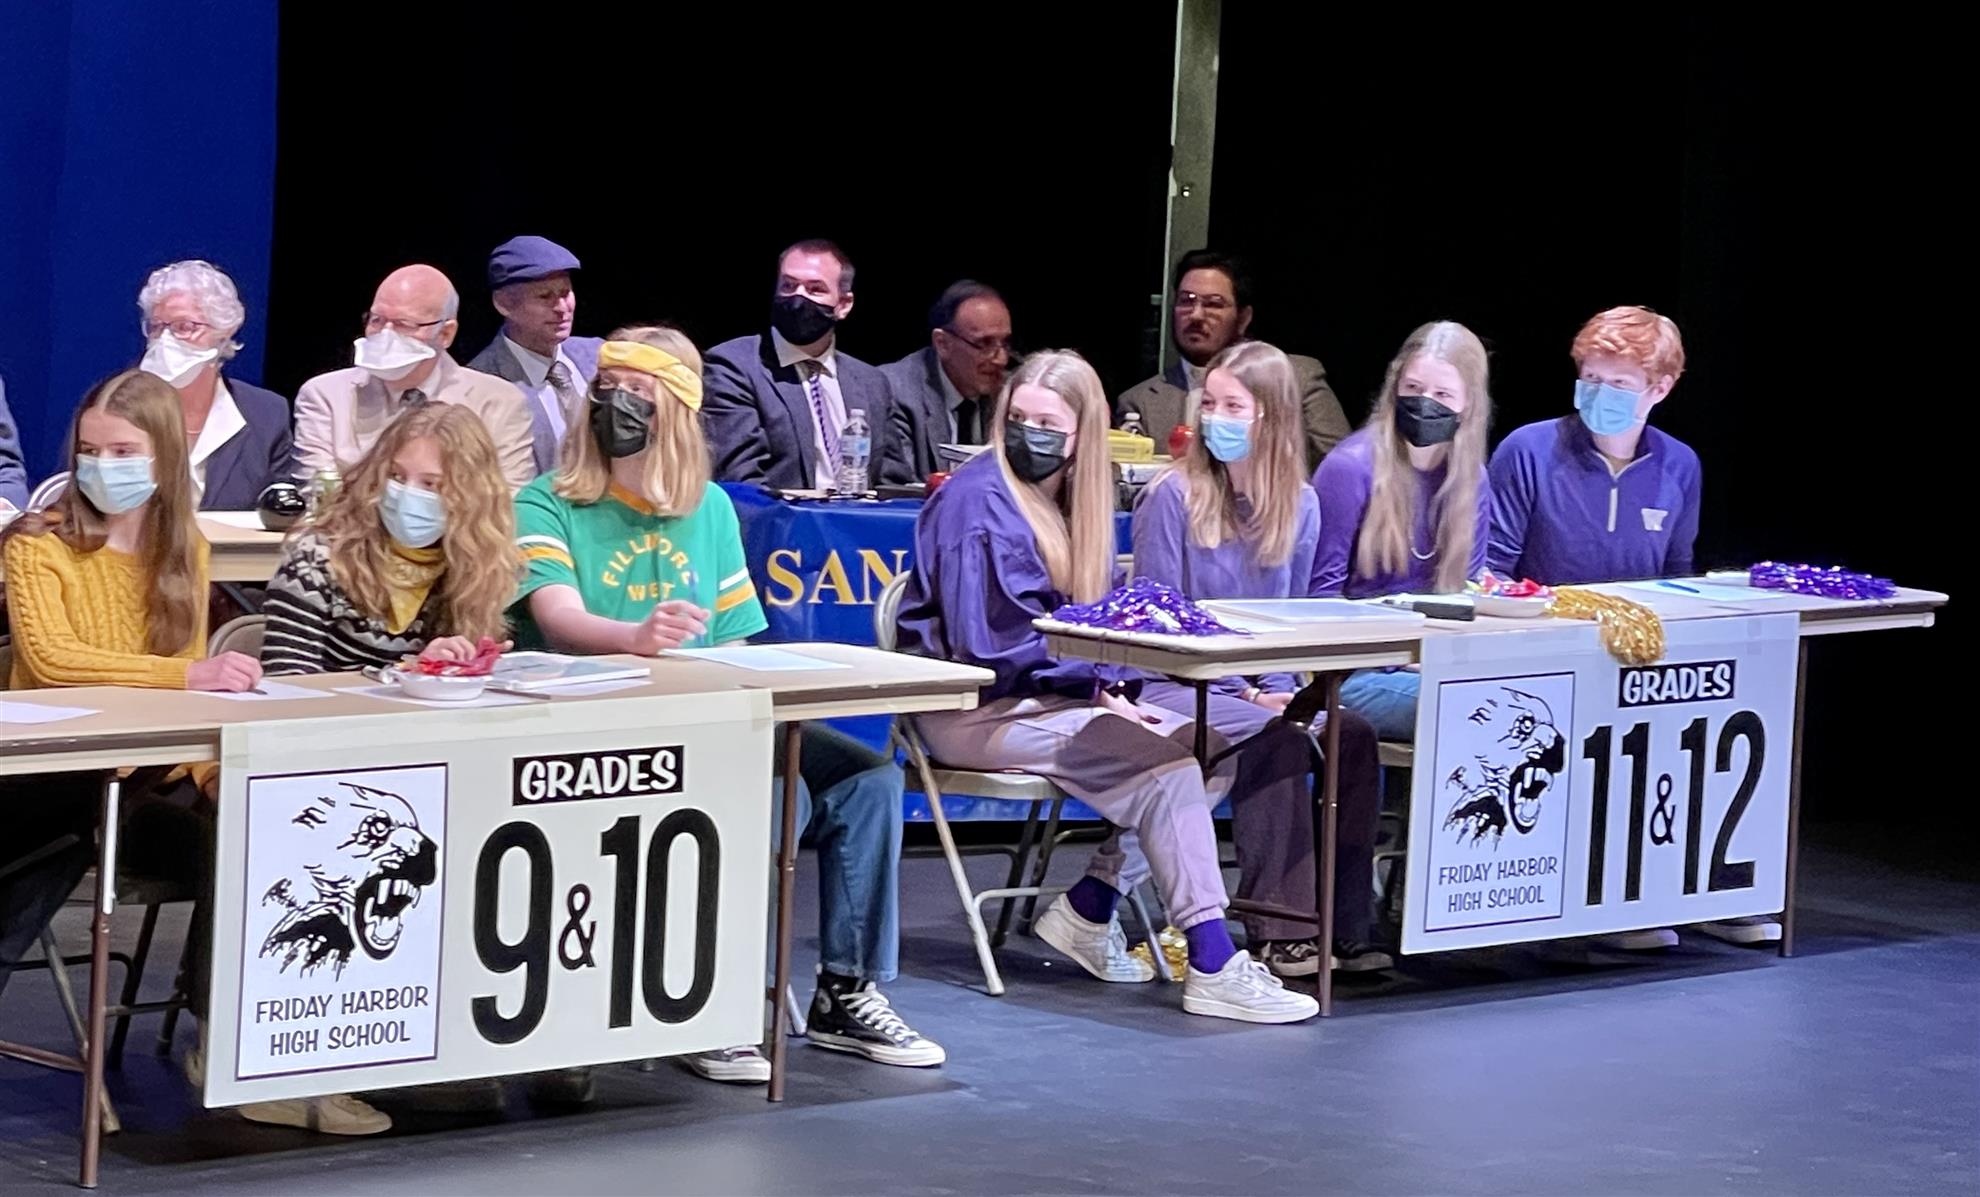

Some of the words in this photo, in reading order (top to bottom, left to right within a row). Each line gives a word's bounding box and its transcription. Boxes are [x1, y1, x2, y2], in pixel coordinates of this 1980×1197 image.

[765, 549, 909, 606] SAN
[1623, 663, 1731, 704] GRADES
[520, 749, 677, 801] GRADES
[1438, 862, 1493, 886] FRIDAY
[1497, 856, 1558, 881] HARBOR
[1447, 890, 1483, 913] HIGH
[1487, 885, 1545, 909] SCHOOL
[255, 994, 333, 1024] FRIDAY
[341, 985, 429, 1015] HARBOR
[270, 1029, 319, 1056] HIGH
[327, 1020, 411, 1050] SCHOOL
